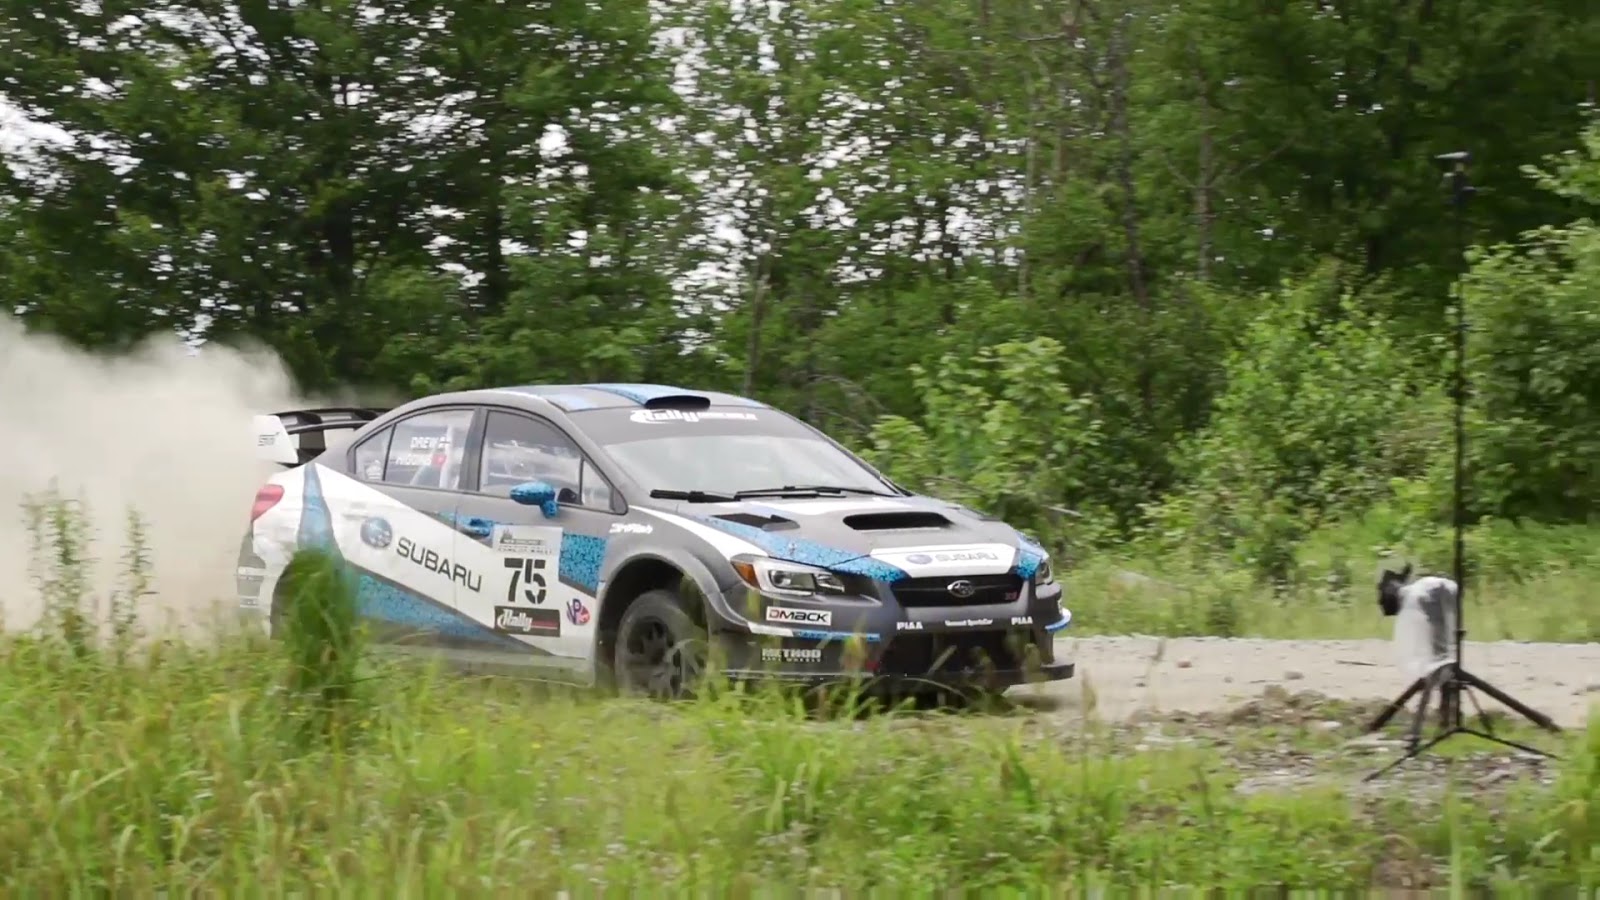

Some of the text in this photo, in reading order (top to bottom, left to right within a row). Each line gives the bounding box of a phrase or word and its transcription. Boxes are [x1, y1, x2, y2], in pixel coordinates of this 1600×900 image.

[935, 552, 998, 561] SUBARU
[396, 536, 482, 593] SUBARU
[504, 557, 546, 605] 75
[497, 608, 533, 632] Rally
[1011, 616, 1033, 625] PIAA
[896, 621, 923, 631] PIAA
[762, 648, 821, 658] METHOD
